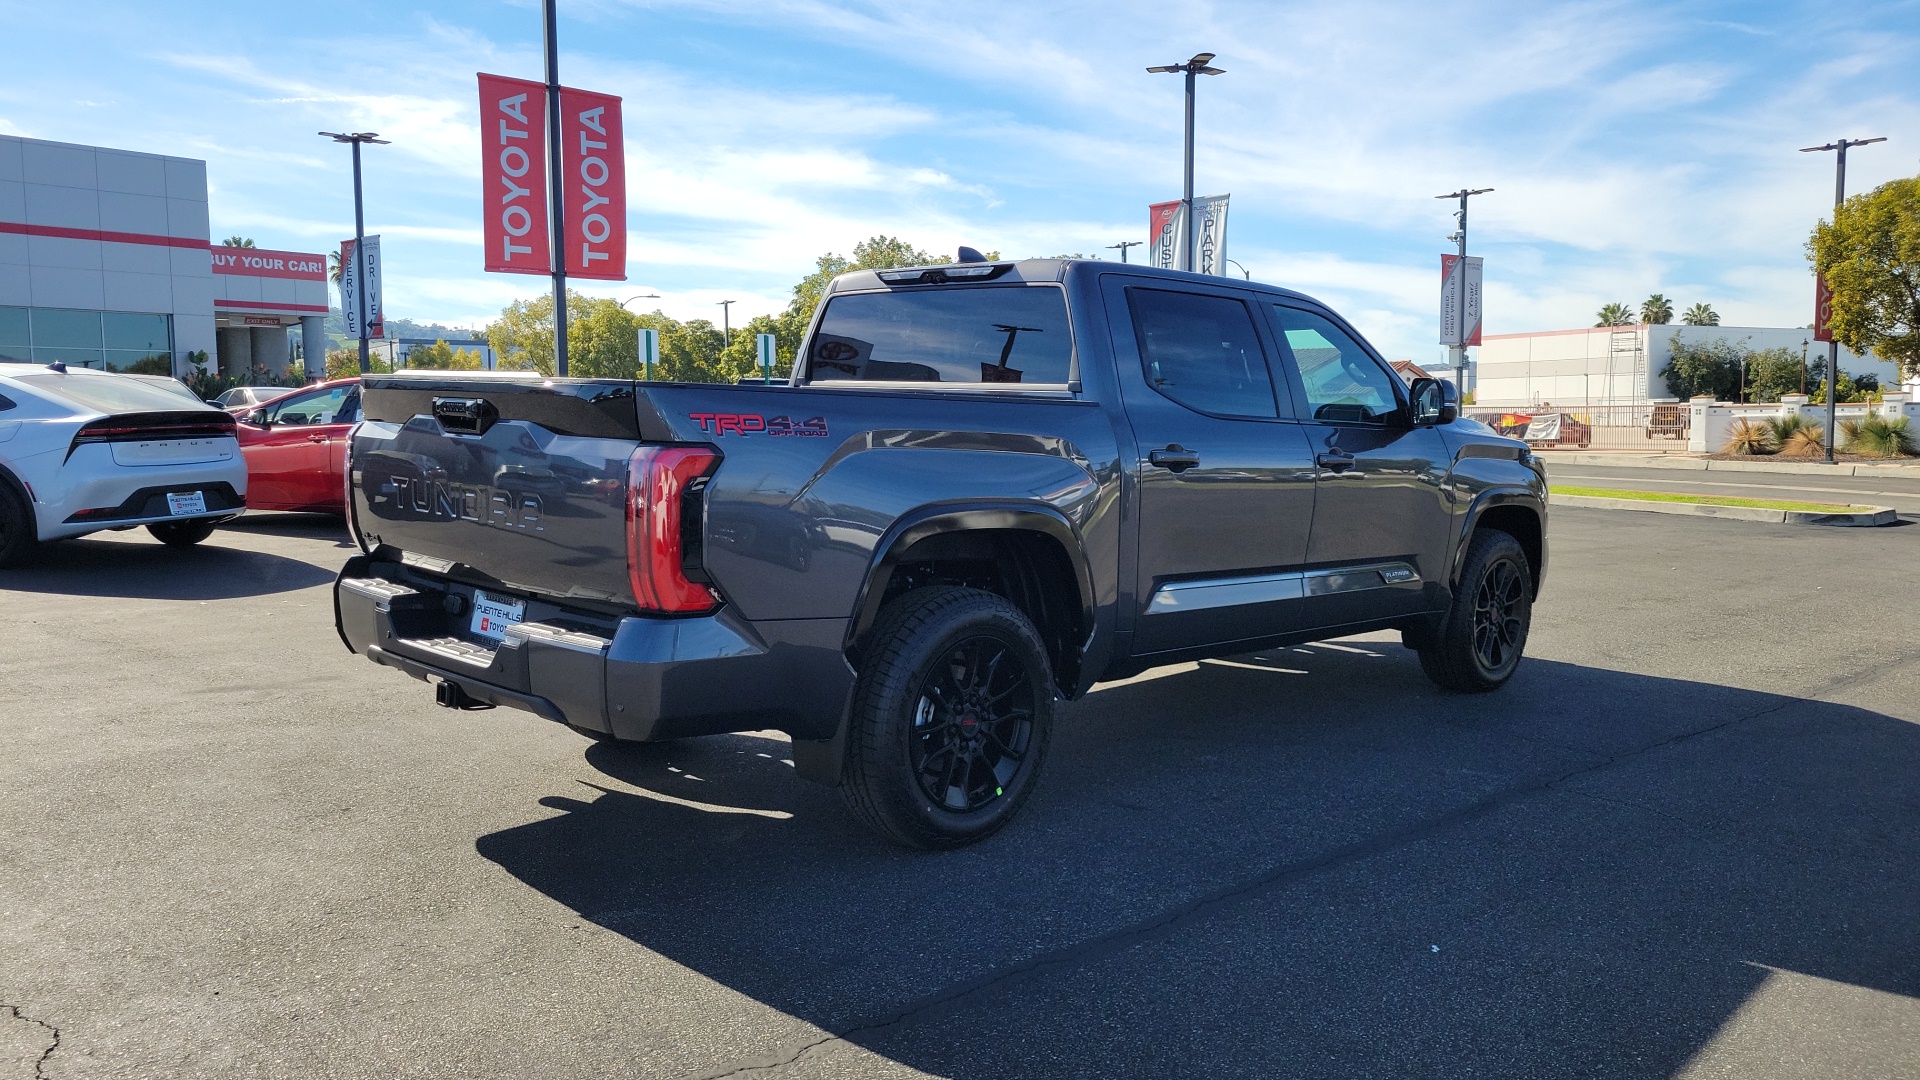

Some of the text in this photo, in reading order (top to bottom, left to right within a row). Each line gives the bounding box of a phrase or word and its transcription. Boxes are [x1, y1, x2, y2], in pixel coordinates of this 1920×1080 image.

[499, 93, 532, 261] TOYOTA
[579, 106, 611, 268] TOYOTA
[241, 256, 284, 271] YOUR
[288, 260, 323, 273] CAR!
[1202, 219, 1215, 275] PARK
[346, 255, 356, 333] SERVICE
[368, 254, 378, 316] DRIVE
[689, 413, 766, 437] TRD
[390, 475, 544, 531] TUNDRA
[476, 604, 521, 622] PUENTE HILLS
